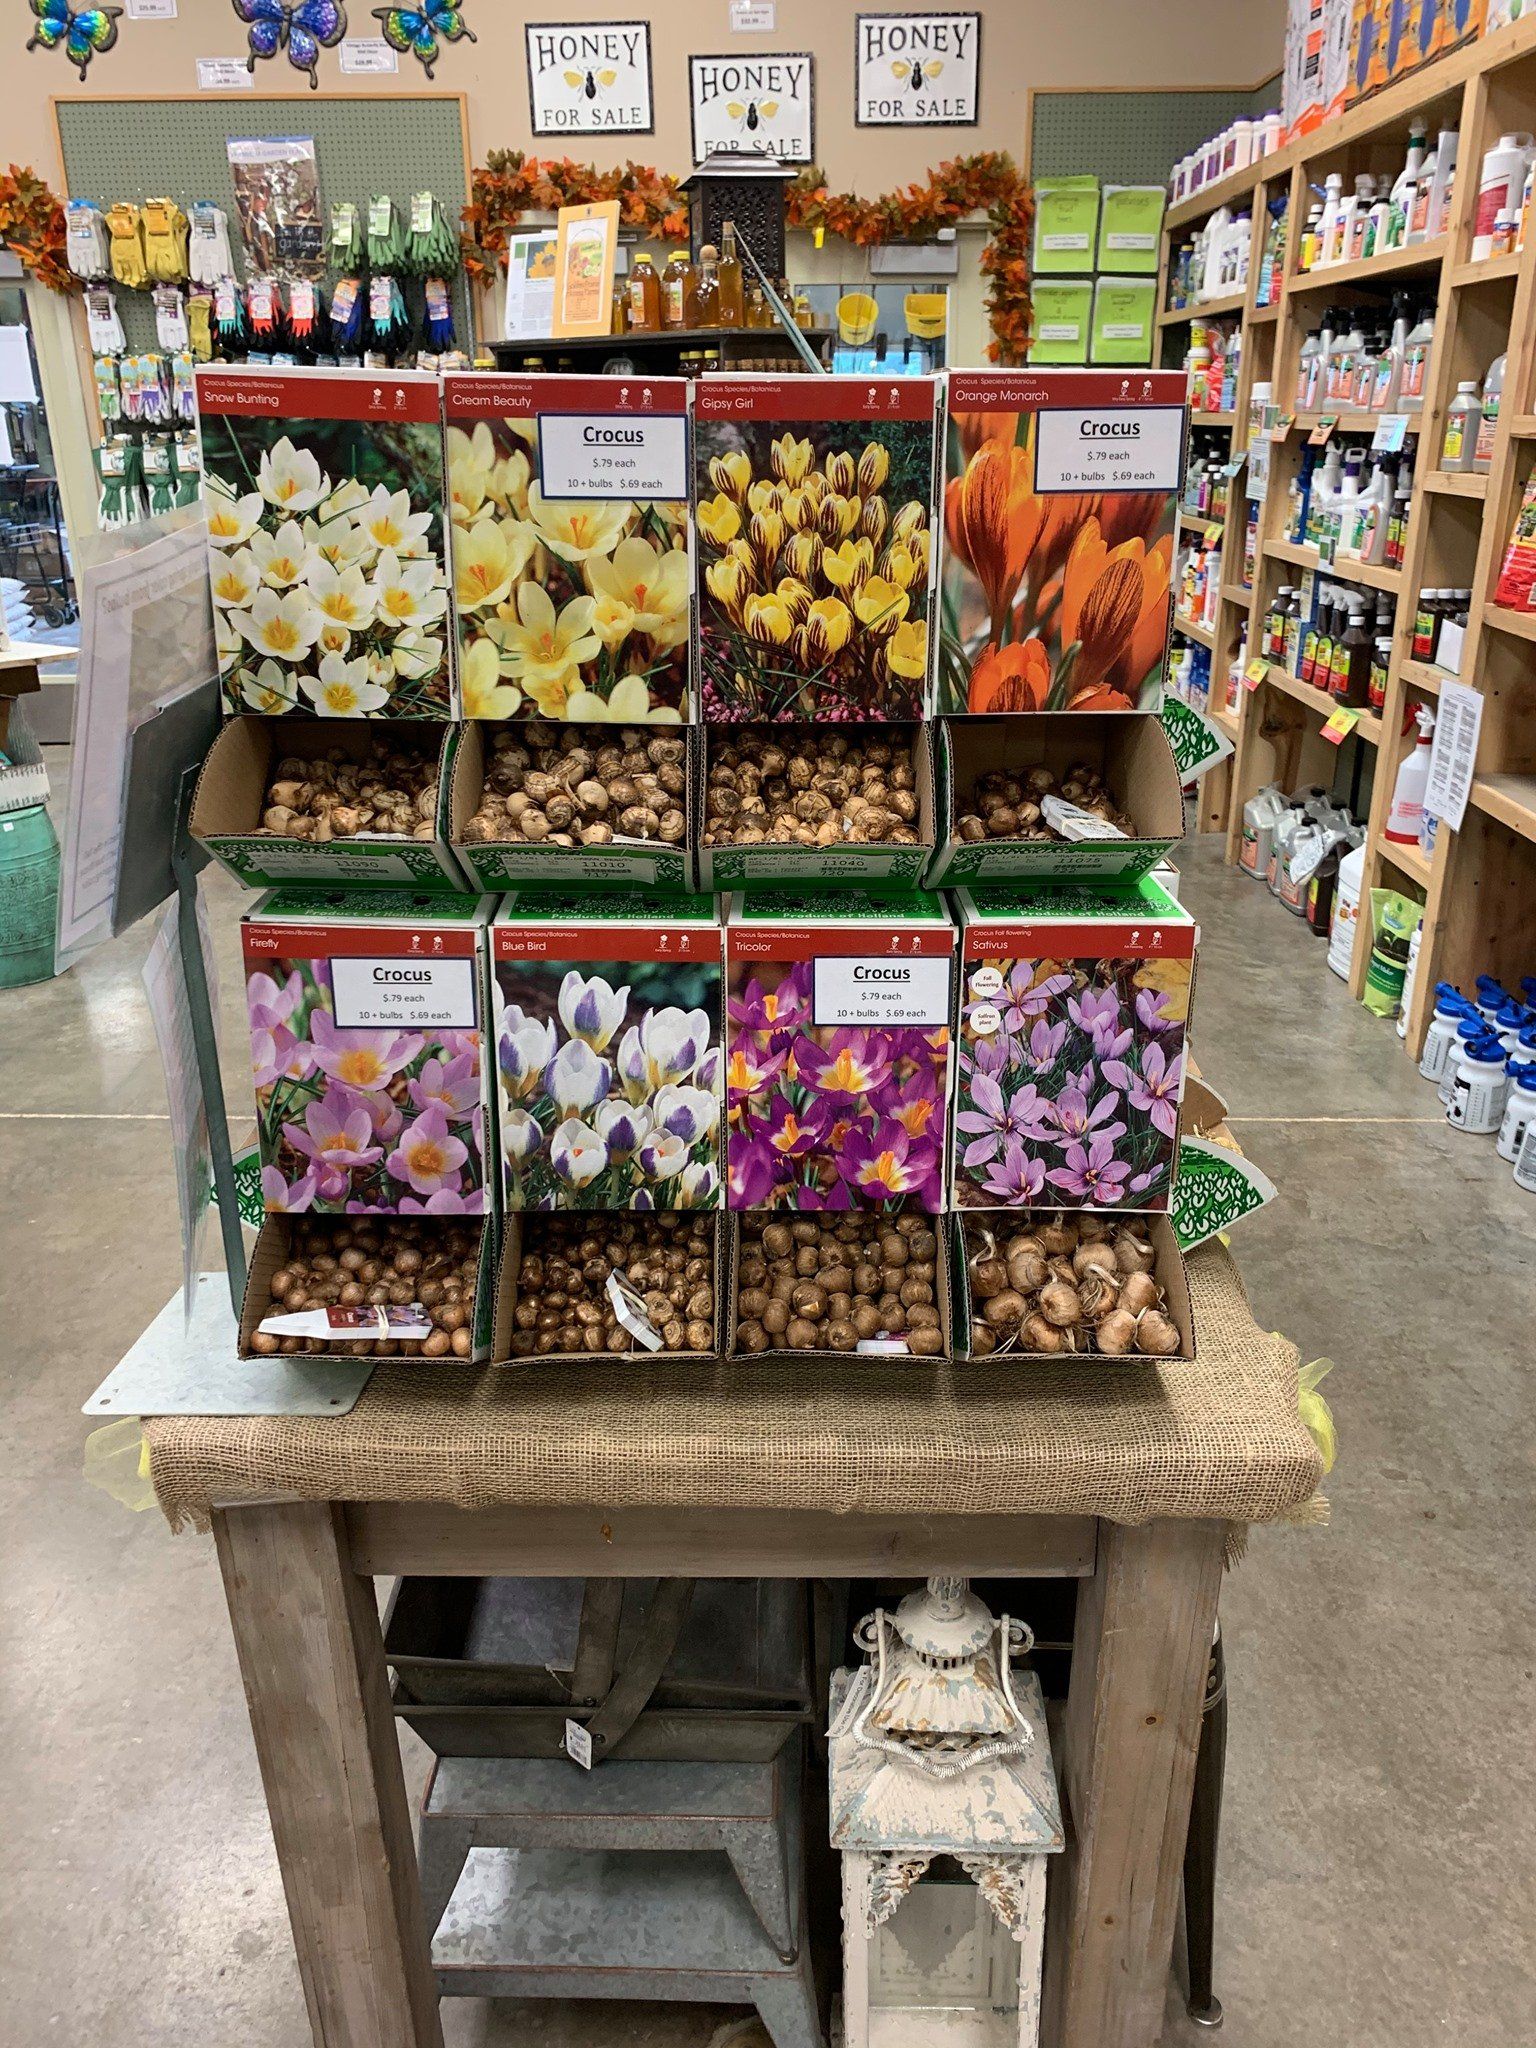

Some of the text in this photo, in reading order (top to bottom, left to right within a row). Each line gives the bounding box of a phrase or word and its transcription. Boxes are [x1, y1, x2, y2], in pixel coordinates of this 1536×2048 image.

[864, 23, 971, 63] HONEY
[536, 33, 639, 73] HONEY
[700, 63, 803, 103] HONEY
[868, 99, 966, 118] FOR SALE
[544, 107, 642, 127] FOR SALE
[705, 138, 802, 157] FOR SALE
[204, 379, 225, 387] Crocus
[205, 392, 278, 407] Snow Bunting
[453, 395, 531, 409] Cream Beauty
[955, 390, 1049, 403] Orange Monarch
[702, 397, 754, 410] Gipsy Girl
[1080, 419, 1140, 436] Crocus
[584, 426, 644, 443] Crocus
[1087, 451, 1130, 462] $.79 each
[593, 458, 635, 469] $.79 each
[1061, 473, 1070, 481] 10
[1081, 472, 1105, 481] bulbs
[1113, 471, 1131, 481] $.69
[1134, 471, 1154, 480] each
[568, 480, 578, 488] 10
[589, 479, 612, 489] bulbs
[620, 479, 639, 489] $.69
[642, 479, 662, 488] each
[305, 909, 358, 917] Product
[251, 938, 279, 950] Firefly
[502, 941, 546, 951] Blue Bird
[735, 942, 772, 952] Tricolor
[973, 939, 1008, 950] Sativus
[373, 967, 431, 982] Crocus
[854, 966, 910, 980] Crocus
[383, 994, 425, 1003] $.79 each
[862, 992, 901, 1001] $.79 each
[359, 1011, 369, 1019] 10
[380, 1011, 403, 1019] bulbs
[410, 1011, 428, 1020] $.69
[837, 1009, 847, 1017] 10
[857, 1009, 879, 1018] bulbs
[886, 1009, 904, 1018] $.69
[906, 1009, 926, 1017] each
